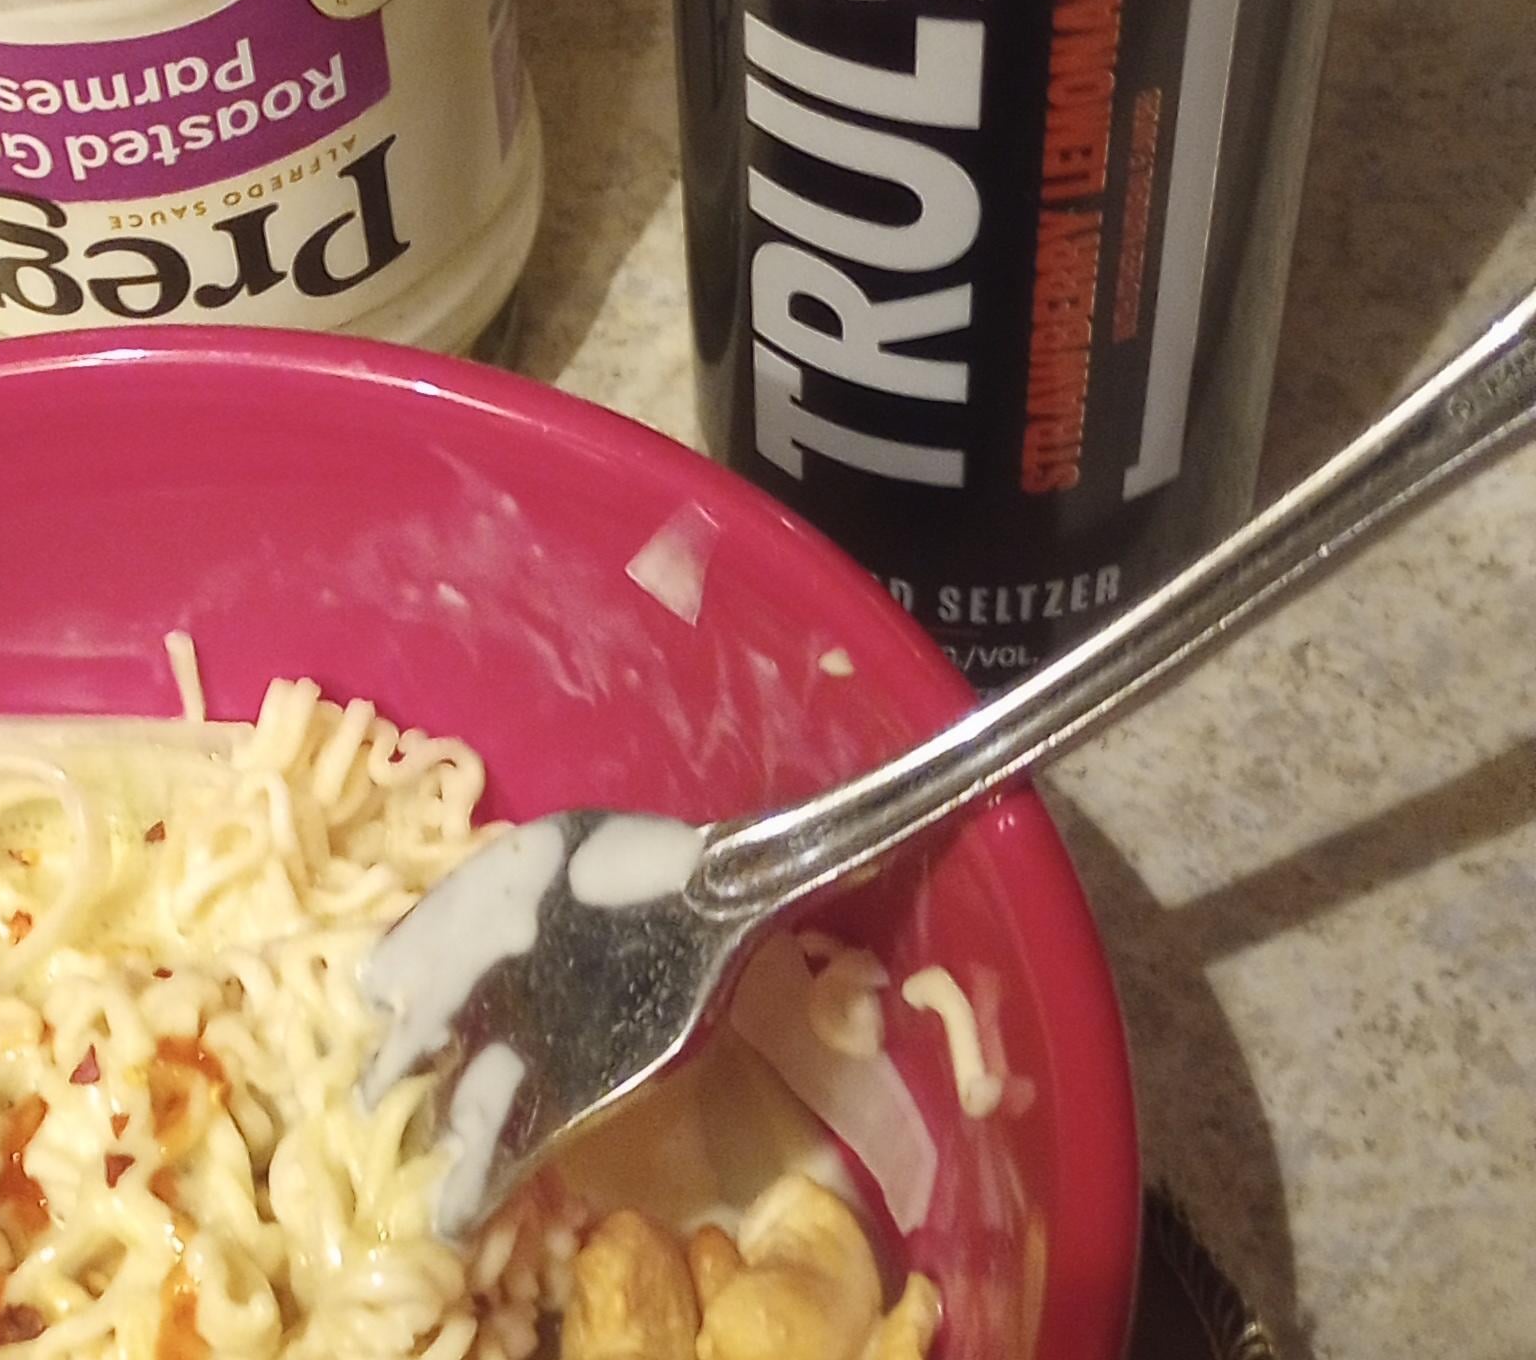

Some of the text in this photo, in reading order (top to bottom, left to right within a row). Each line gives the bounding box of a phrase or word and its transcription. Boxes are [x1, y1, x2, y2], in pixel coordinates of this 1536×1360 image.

[66, 51, 350, 181] Roasted
[107, 133, 358, 231] ALFREDO SAUCE
[1020, 209, 1104, 495] STRAWBERRY
[936, 564, 1123, 625] SELTZER
